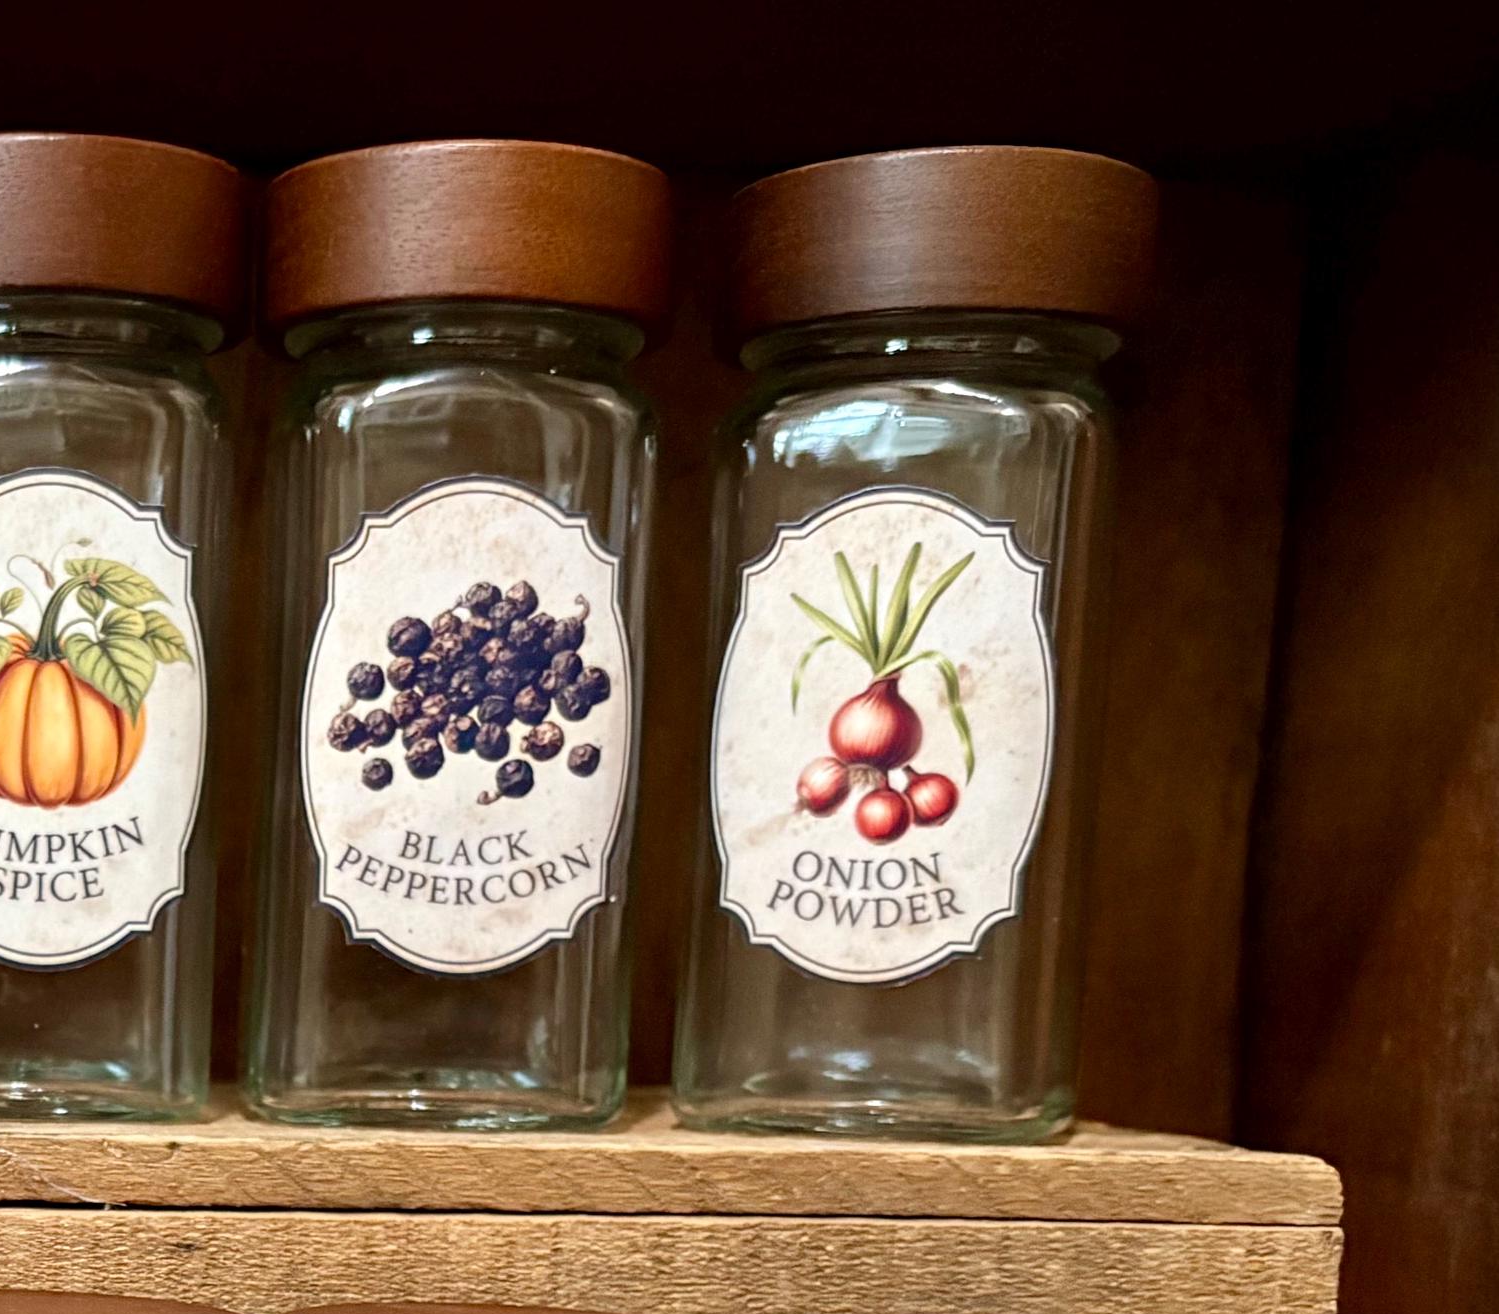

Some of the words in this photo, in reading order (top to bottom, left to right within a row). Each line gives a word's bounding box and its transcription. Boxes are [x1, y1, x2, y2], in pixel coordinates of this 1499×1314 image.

[398, 830, 532, 866] BLACK
[335, 843, 593, 905] PEPPERCORN
[793, 851, 941, 890] ONION
[766, 880, 965, 928] POWDER
